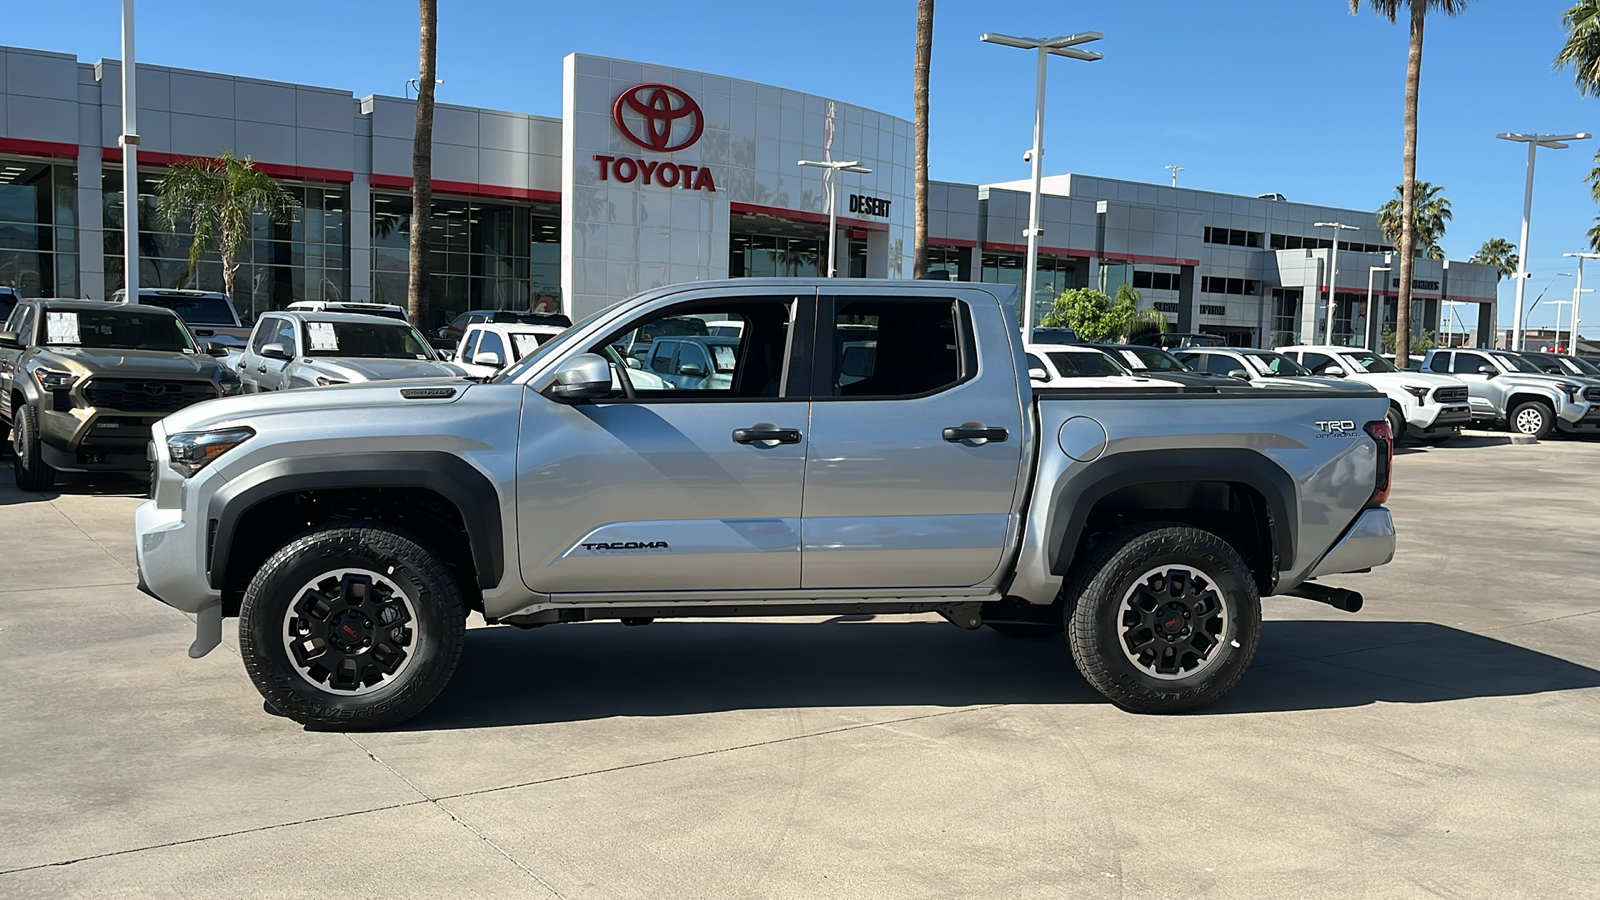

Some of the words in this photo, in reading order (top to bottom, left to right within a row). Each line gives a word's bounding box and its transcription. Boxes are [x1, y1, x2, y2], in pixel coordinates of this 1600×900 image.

[593, 155, 716, 192] TOYOTA
[849, 194, 891, 218] DESERT
[1315, 420, 1355, 433] TRD
[581, 541, 668, 550] TACOMA
